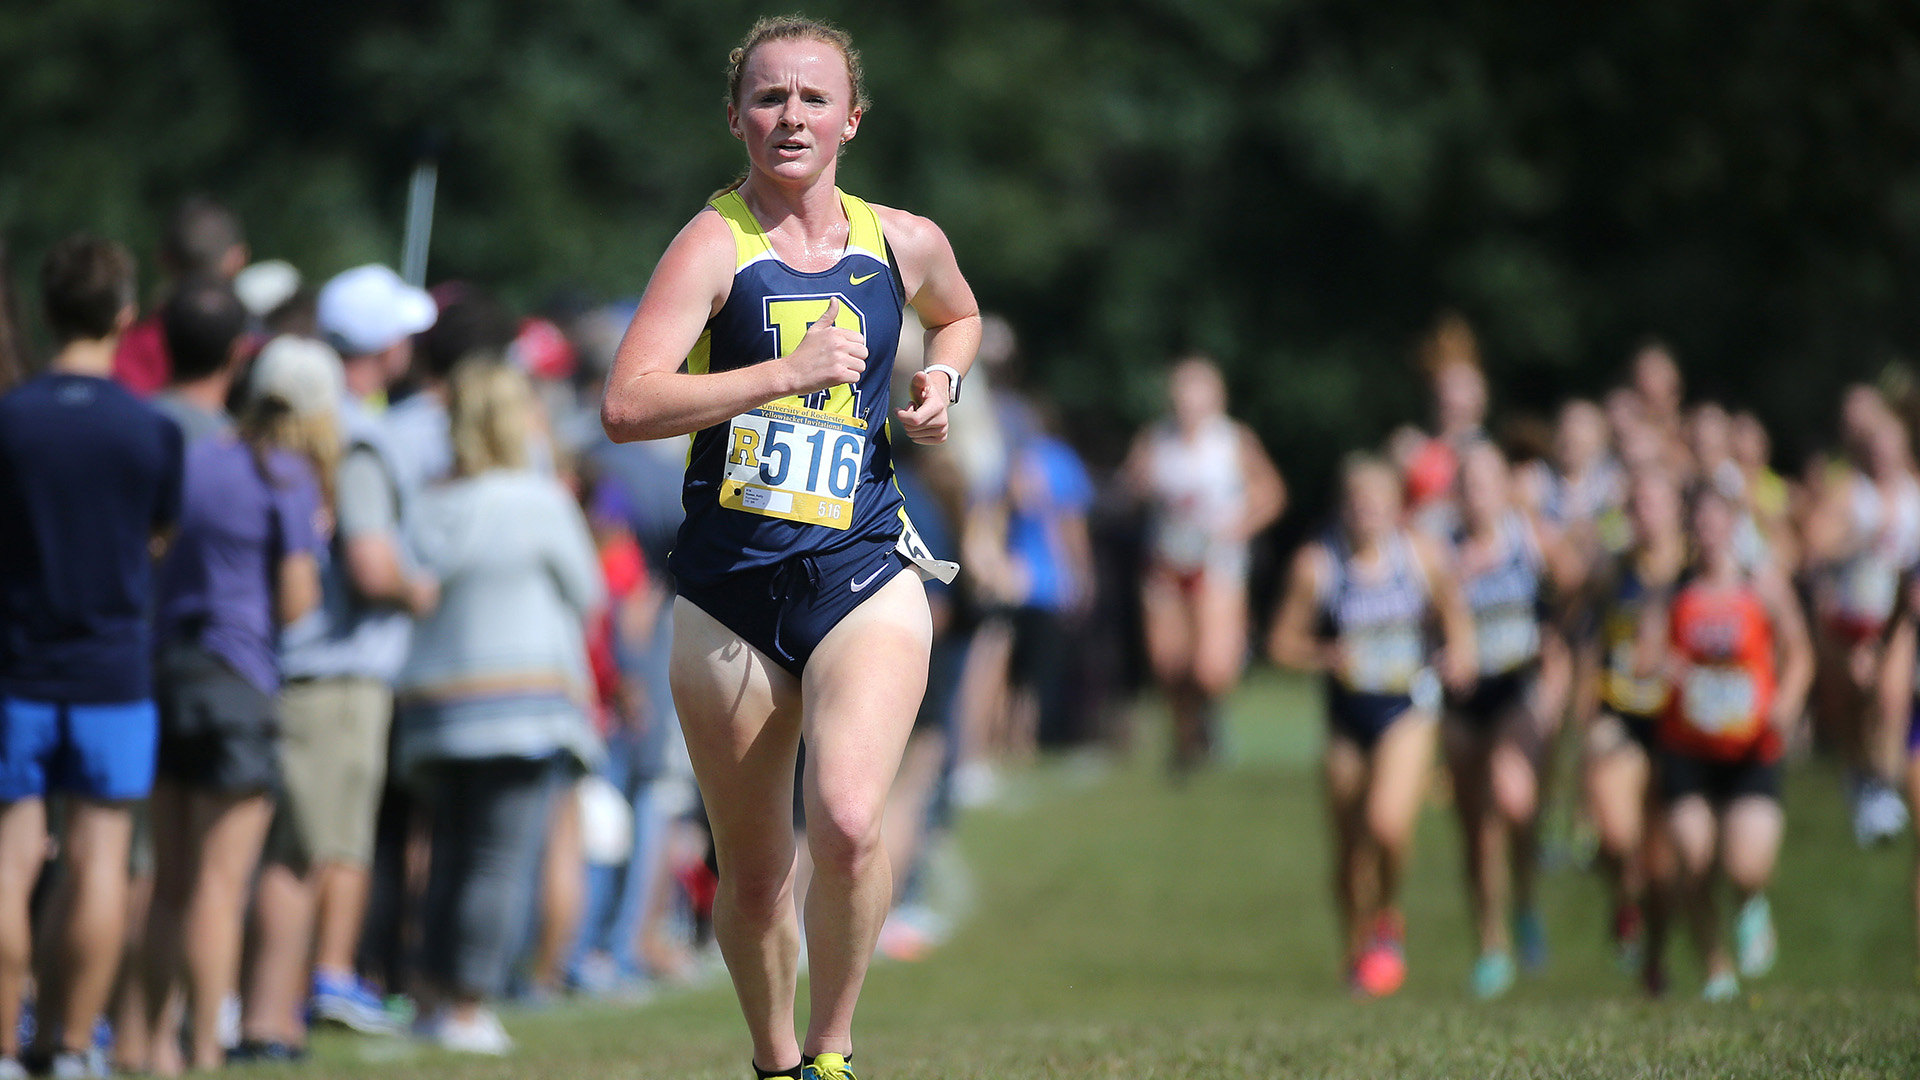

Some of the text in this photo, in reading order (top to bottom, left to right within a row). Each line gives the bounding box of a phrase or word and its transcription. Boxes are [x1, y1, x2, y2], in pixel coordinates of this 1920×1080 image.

[761, 410, 843, 431] Yellowjacket Invitational
[762, 403, 845, 423] University of Rochester
[728, 420, 861, 499] R 516
[817, 500, 842, 520] 516
